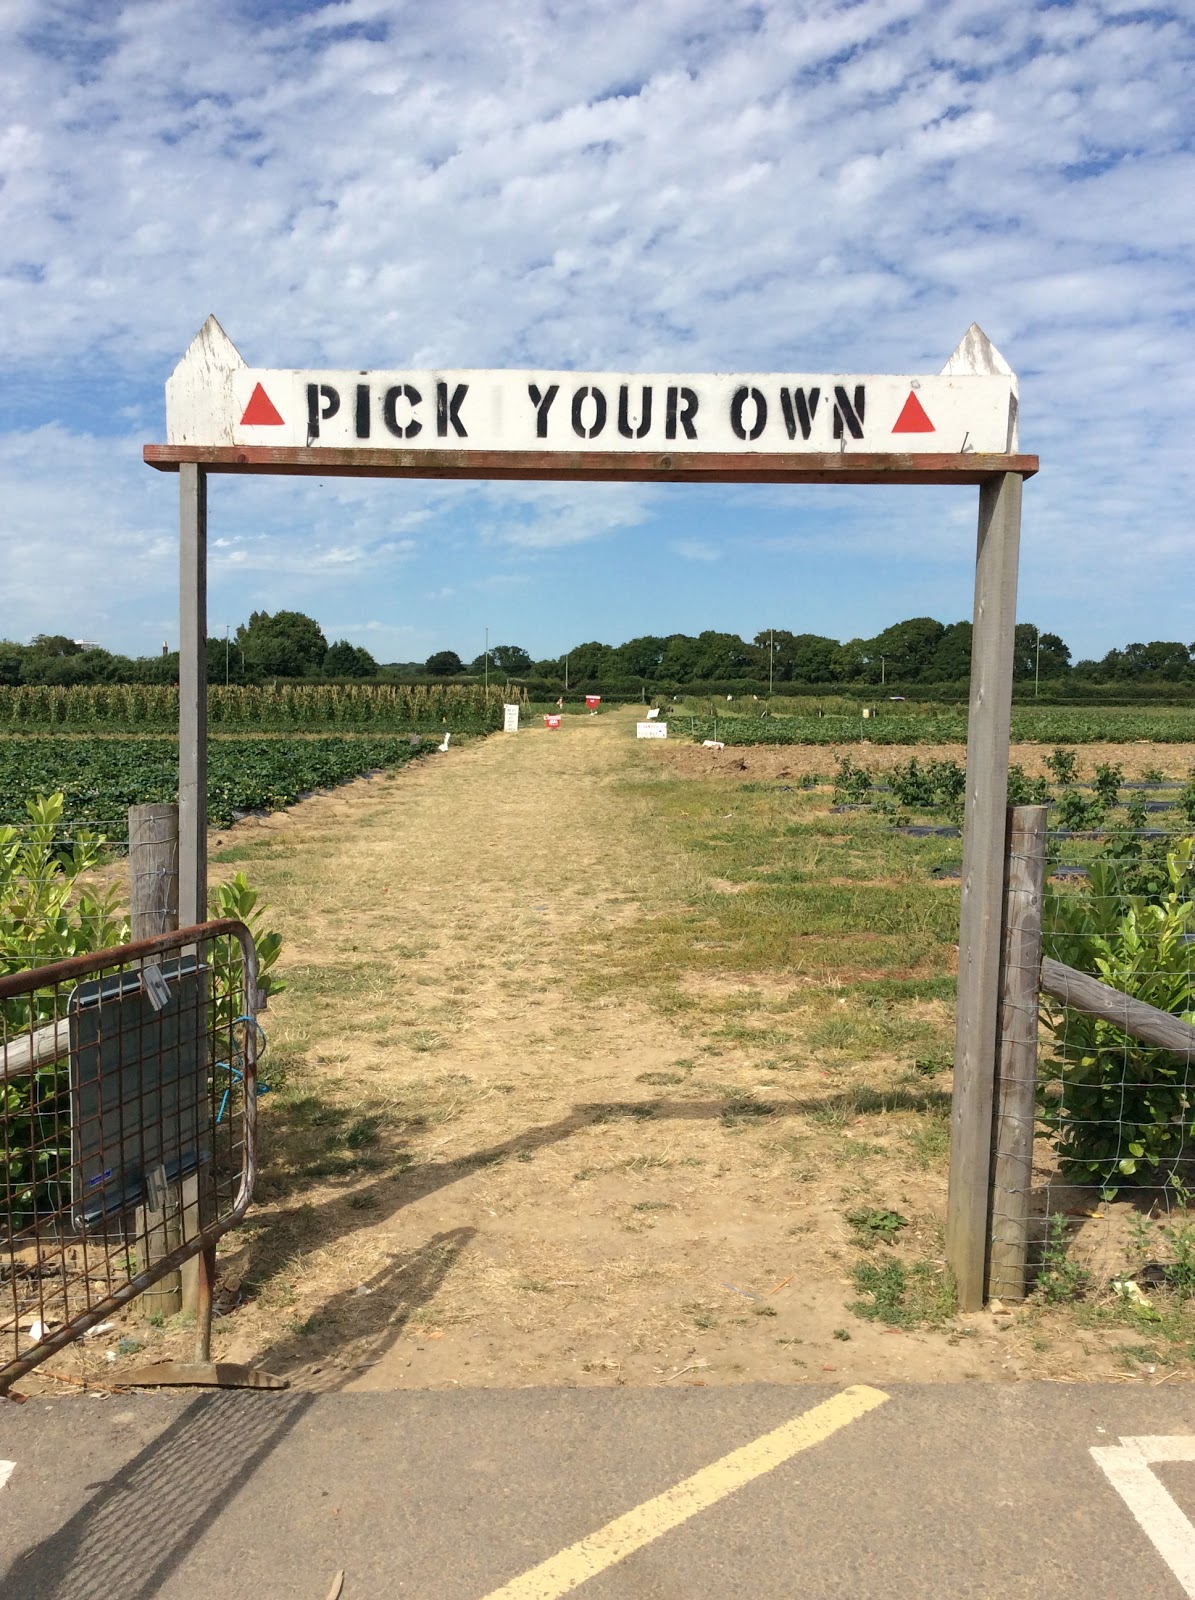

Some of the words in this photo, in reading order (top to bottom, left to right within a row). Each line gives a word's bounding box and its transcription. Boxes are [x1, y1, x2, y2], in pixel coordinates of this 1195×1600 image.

[306, 382, 469, 439] PICK
[527, 384, 700, 440] YOUR
[729, 386, 866, 441] OWN
